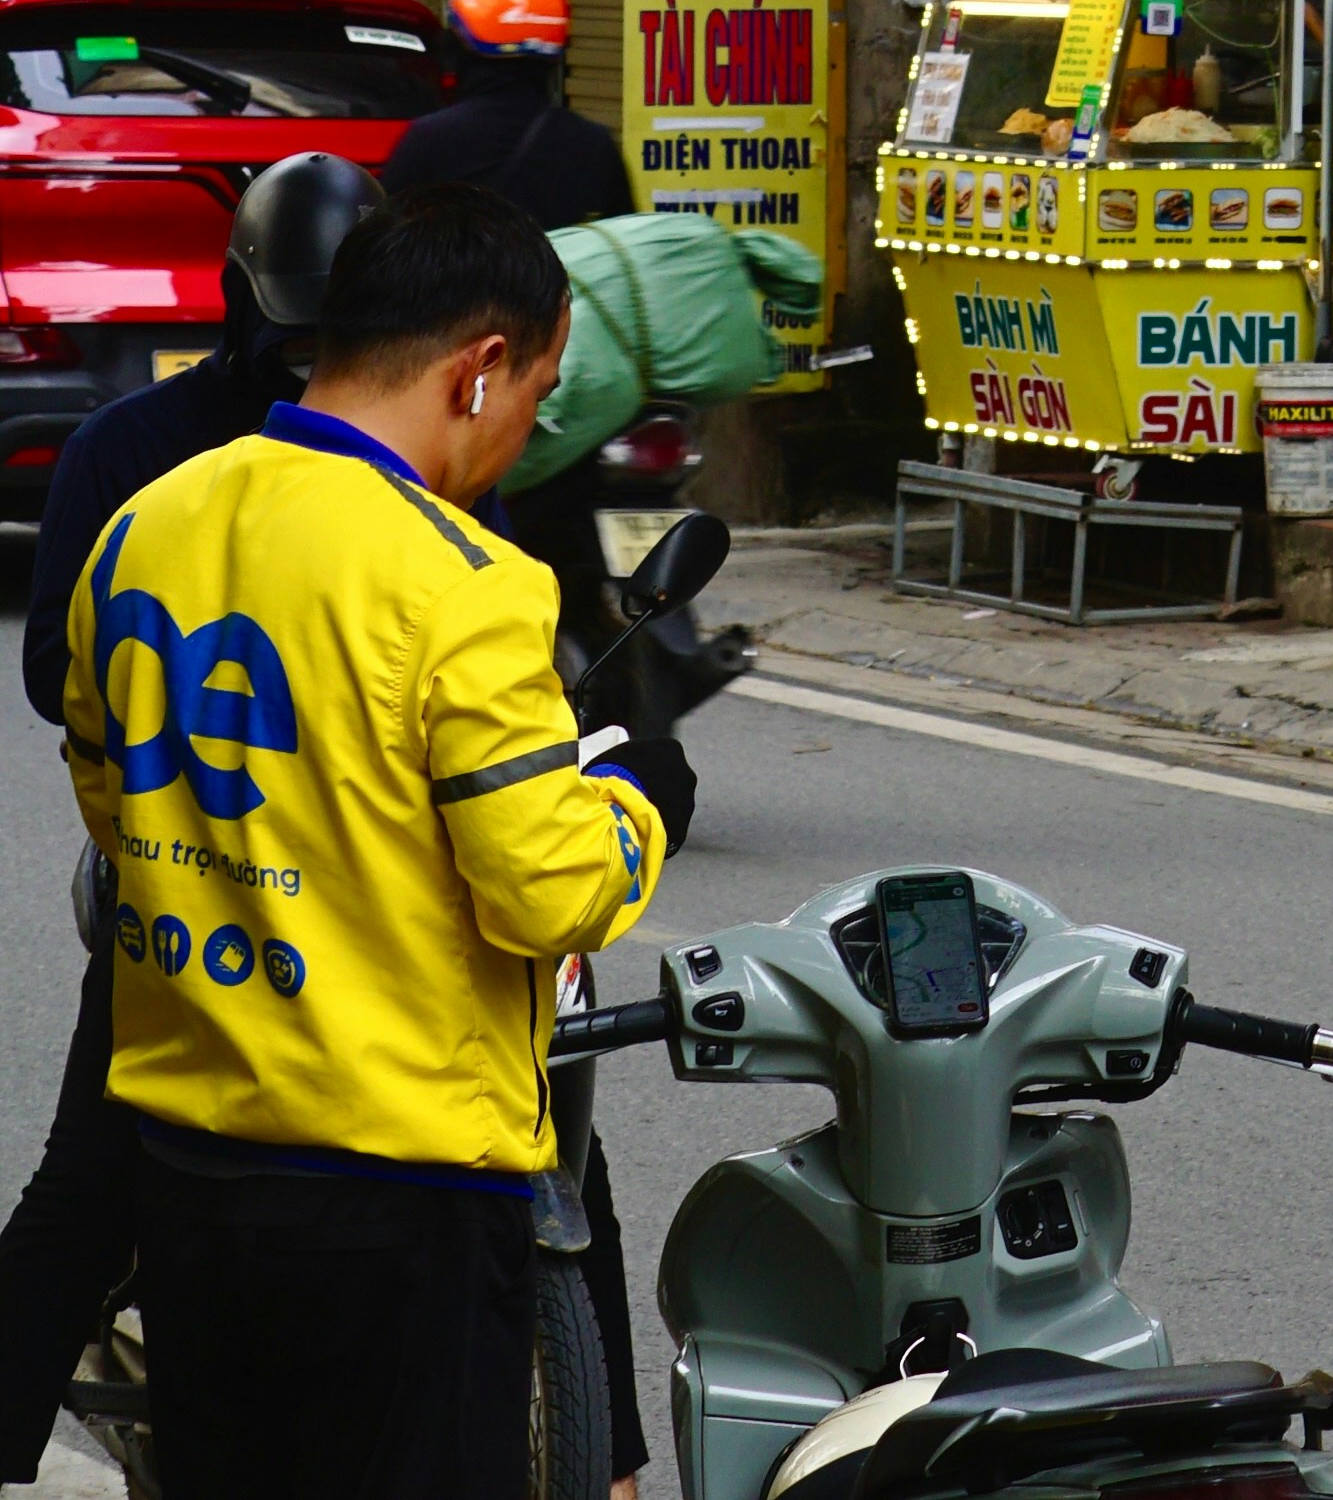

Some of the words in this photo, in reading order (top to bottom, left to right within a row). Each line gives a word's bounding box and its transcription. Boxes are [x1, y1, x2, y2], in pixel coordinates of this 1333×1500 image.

[642, 133, 710, 177] ĐIỆN
[721, 137, 811, 176] THOẠI
[954, 277, 1024, 350] BÁNH
[1028, 286, 1060, 356] MÌ
[1139, 298, 1297, 365] BÁNH
[970, 358, 1017, 425] SÀI
[1018, 365, 1073, 433] GÒN
[1141, 379, 1236, 445] SÀI
[90, 511, 299, 820] be
